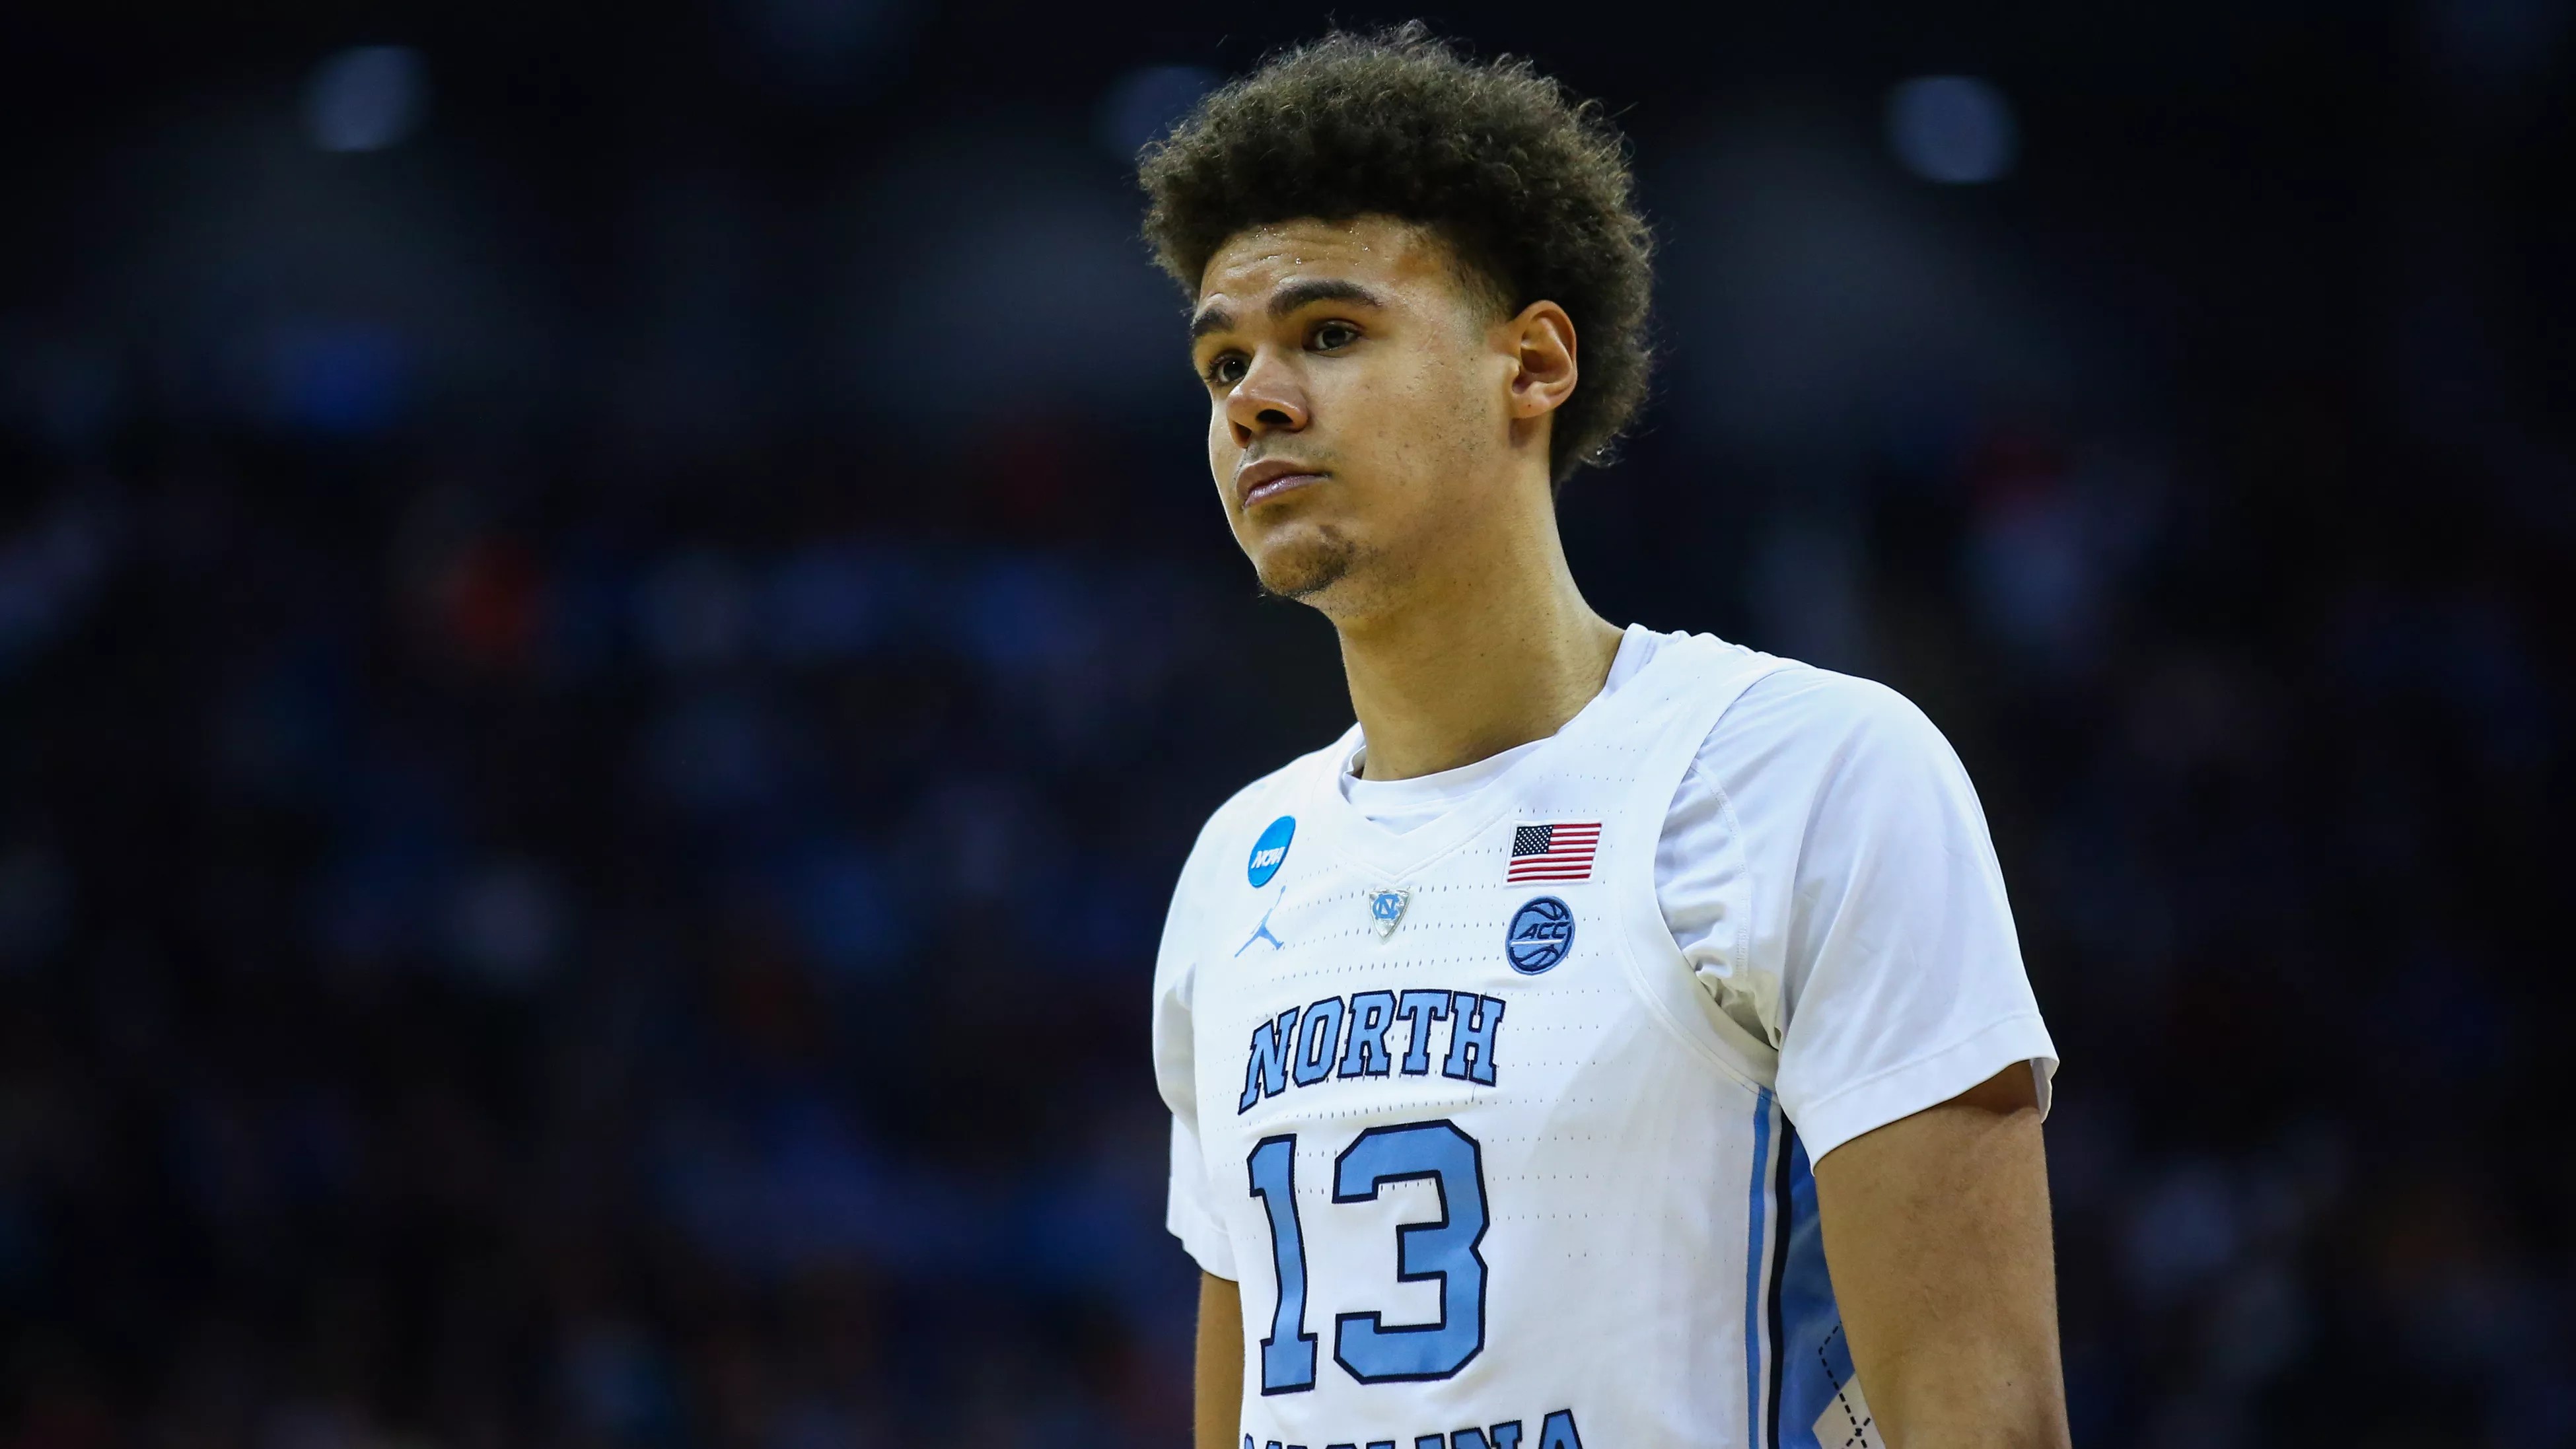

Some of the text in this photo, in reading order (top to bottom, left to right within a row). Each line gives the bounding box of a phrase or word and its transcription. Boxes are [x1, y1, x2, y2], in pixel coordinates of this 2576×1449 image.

[1516, 921, 1570, 940] ACC
[1238, 989, 1506, 1115] NORTH
[1246, 1119, 1490, 1396] 13
